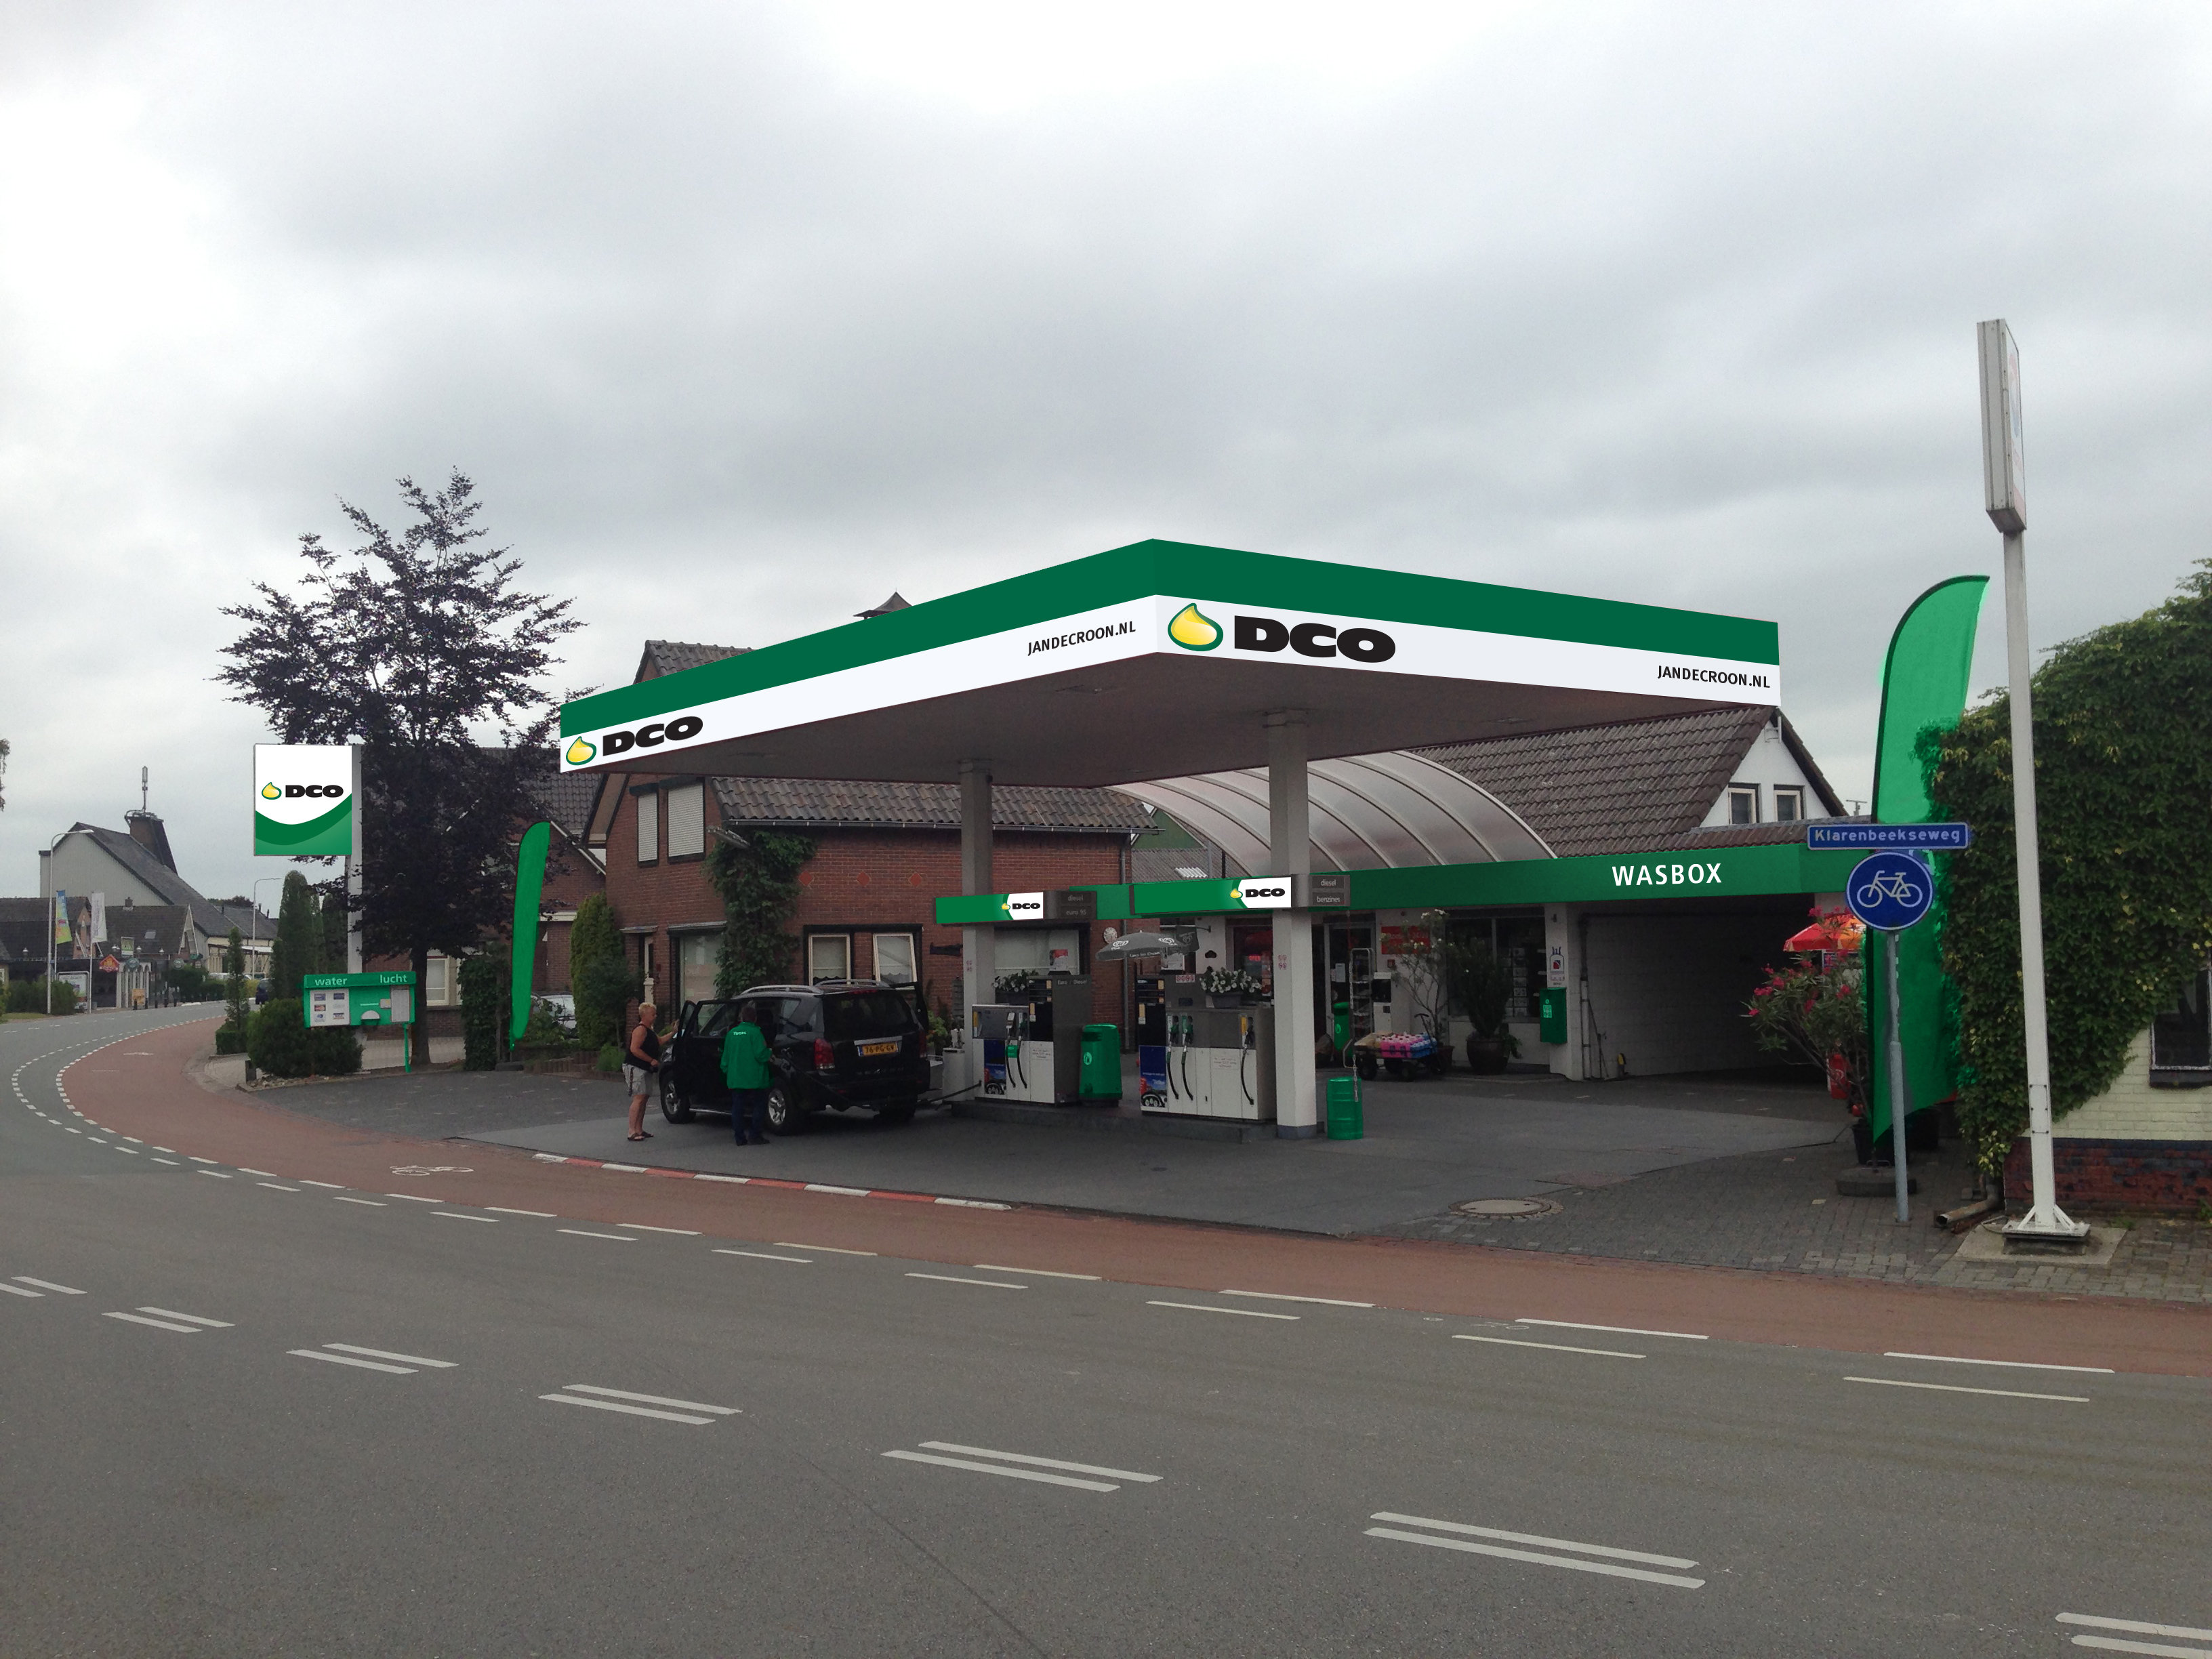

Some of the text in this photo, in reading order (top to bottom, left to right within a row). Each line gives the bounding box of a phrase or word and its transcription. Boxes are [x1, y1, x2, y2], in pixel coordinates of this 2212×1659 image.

[1027, 620, 1136, 656] JANDECROON.NL
[1233, 615, 1396, 663] DCO
[1657, 665, 1771, 689] JANDECROON.NL
[602, 716, 703, 756] DCO
[285, 784, 344, 798] DCO
[1814, 829, 1961, 844] Klarenbeekseweg
[1612, 863, 1722, 886] WASBOX
[1320, 878, 1336, 886] diesel
[1245, 888, 1286, 898] DCO
[1316, 895, 1340, 903] benzines
[1012, 902, 1041, 910] DCO
[314, 977, 348, 986] water
[380, 973, 408, 983] lucht
